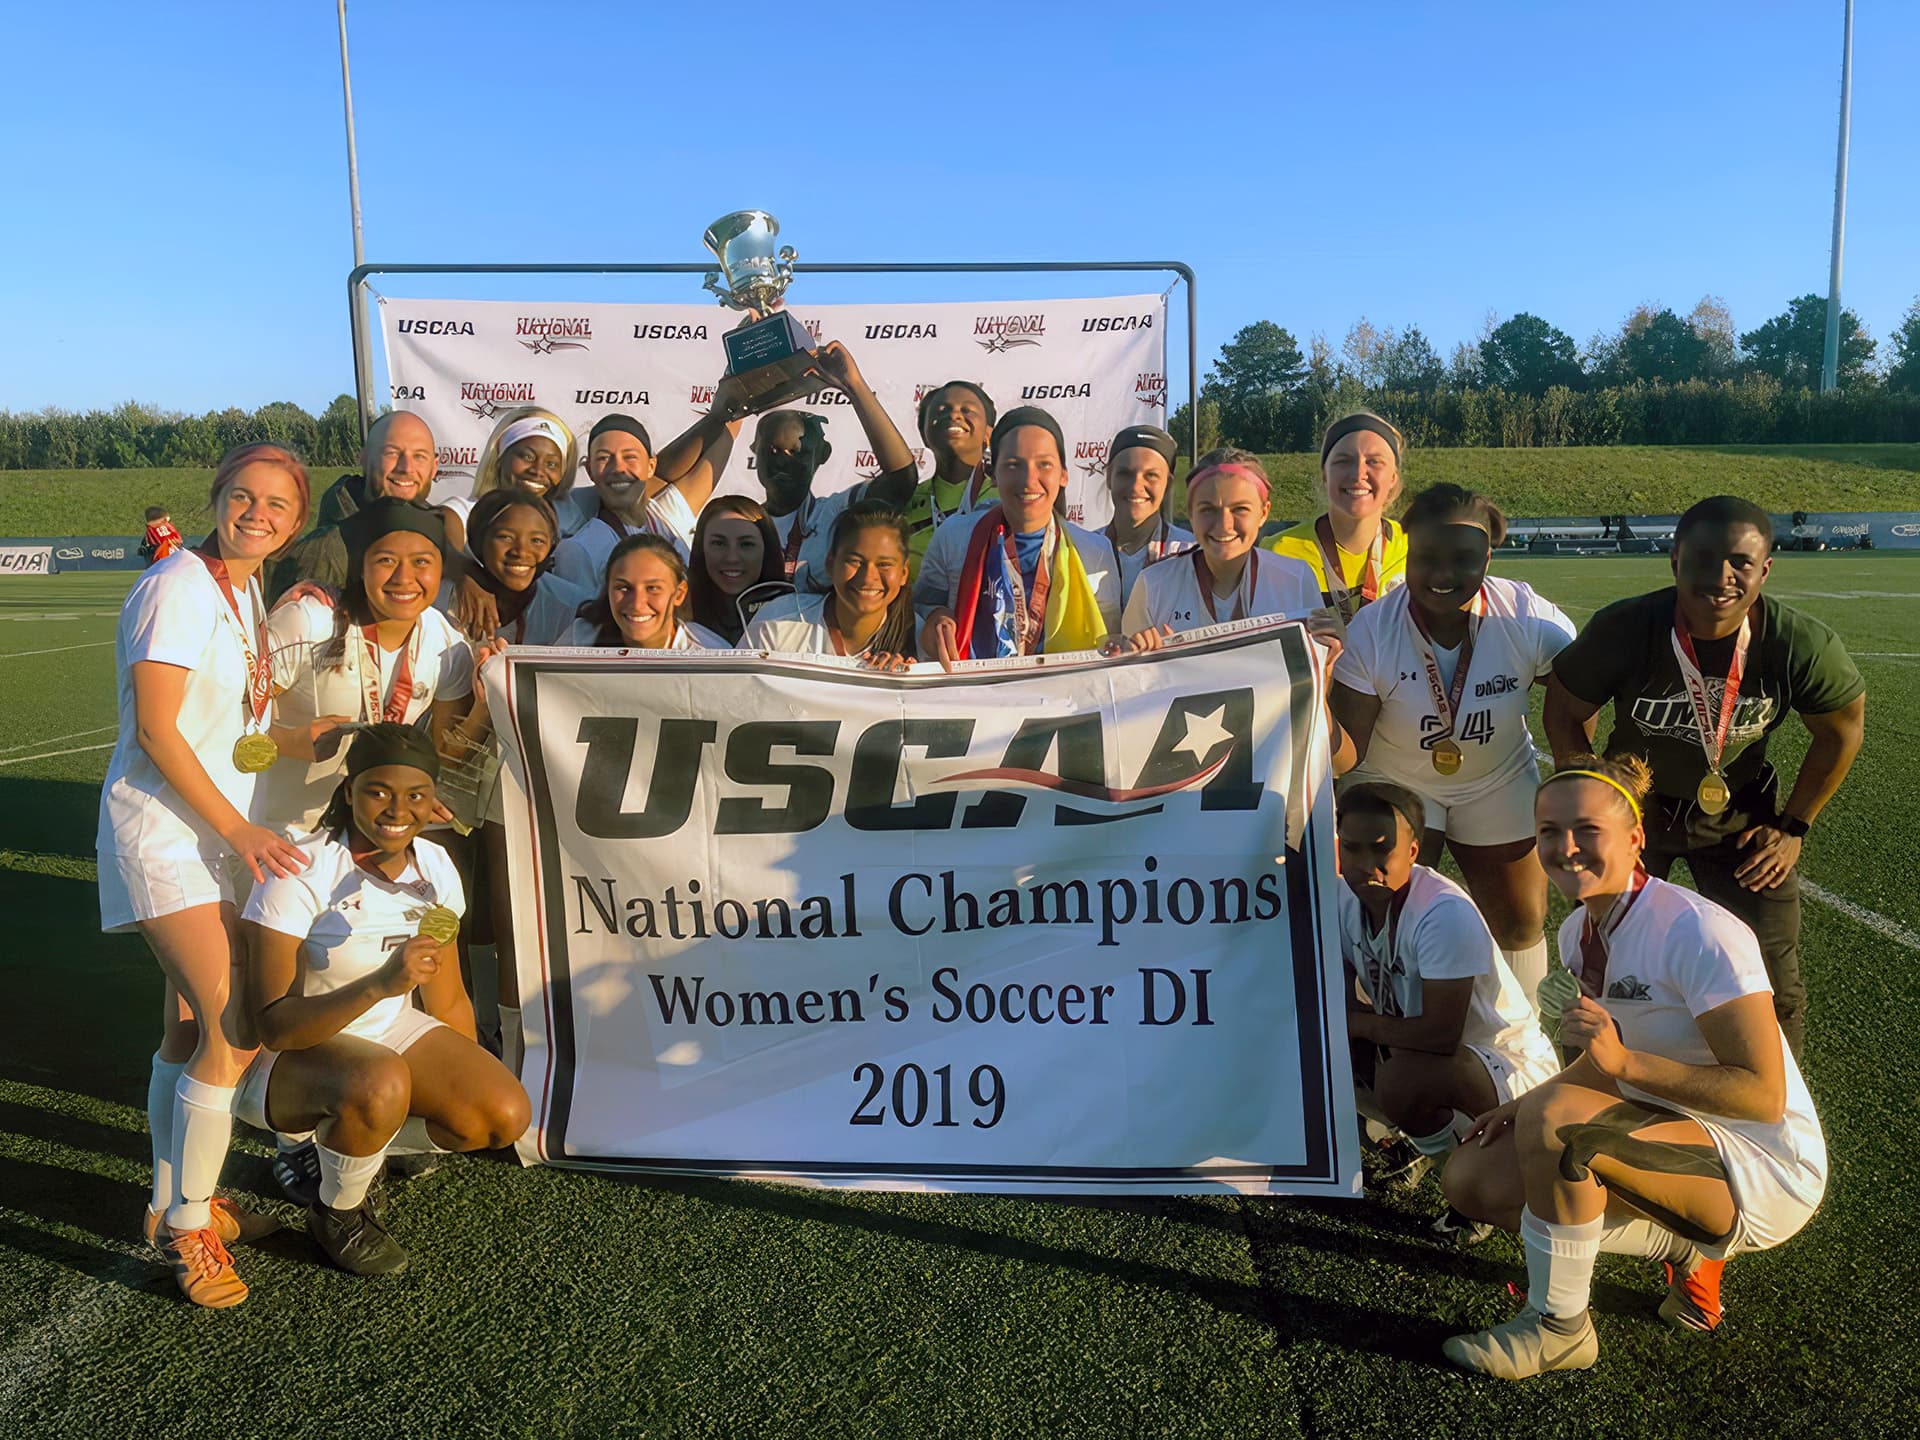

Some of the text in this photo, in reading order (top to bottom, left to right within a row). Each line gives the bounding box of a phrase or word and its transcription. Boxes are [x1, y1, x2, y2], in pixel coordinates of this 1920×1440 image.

[399, 319, 475, 336] USCAA
[633, 324, 708, 340] USCAA
[865, 323, 938, 340] USCAA
[1081, 314, 1152, 333] USCAA
[575, 389, 650, 405] USCAA
[804, 391, 853, 406] USC
[1021, 382, 1092, 400] USCAA
[0, 552, 46, 571] CAA
[574, 687, 1266, 839] USCAA
[571, 855, 1284, 948] National Champions
[647, 966, 1216, 1027] Women's Soccer DI
[848, 1061, 1007, 1130] 2019
